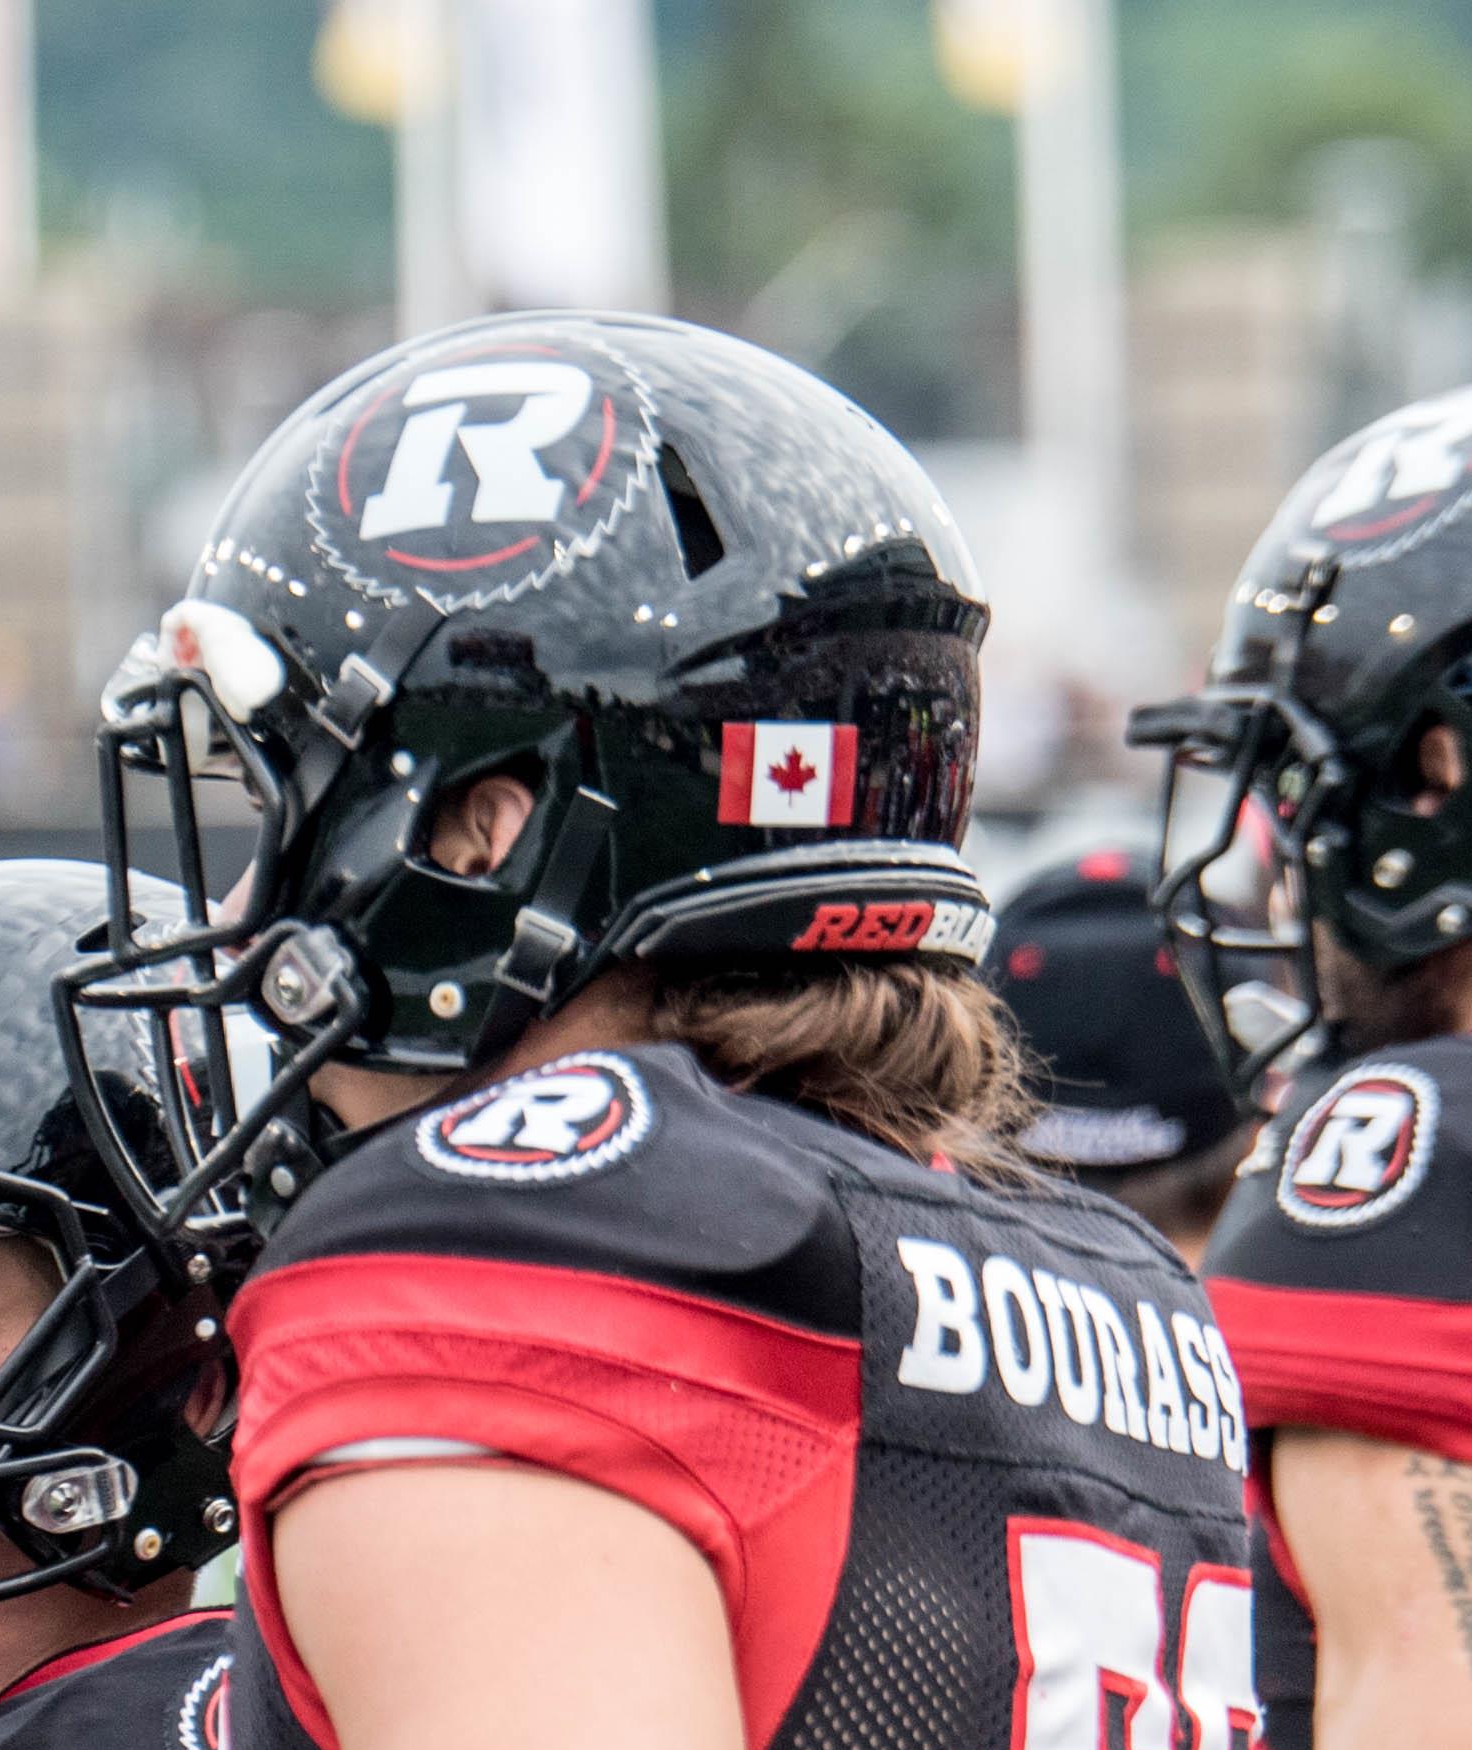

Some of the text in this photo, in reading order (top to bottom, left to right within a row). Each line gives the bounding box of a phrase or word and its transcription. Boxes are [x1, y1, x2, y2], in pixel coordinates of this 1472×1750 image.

[359, 361, 593, 541] R
[447, 1074, 613, 1154] R
[1292, 1090, 1414, 1192] R
[895, 1235, 1249, 1478] BOURASS
